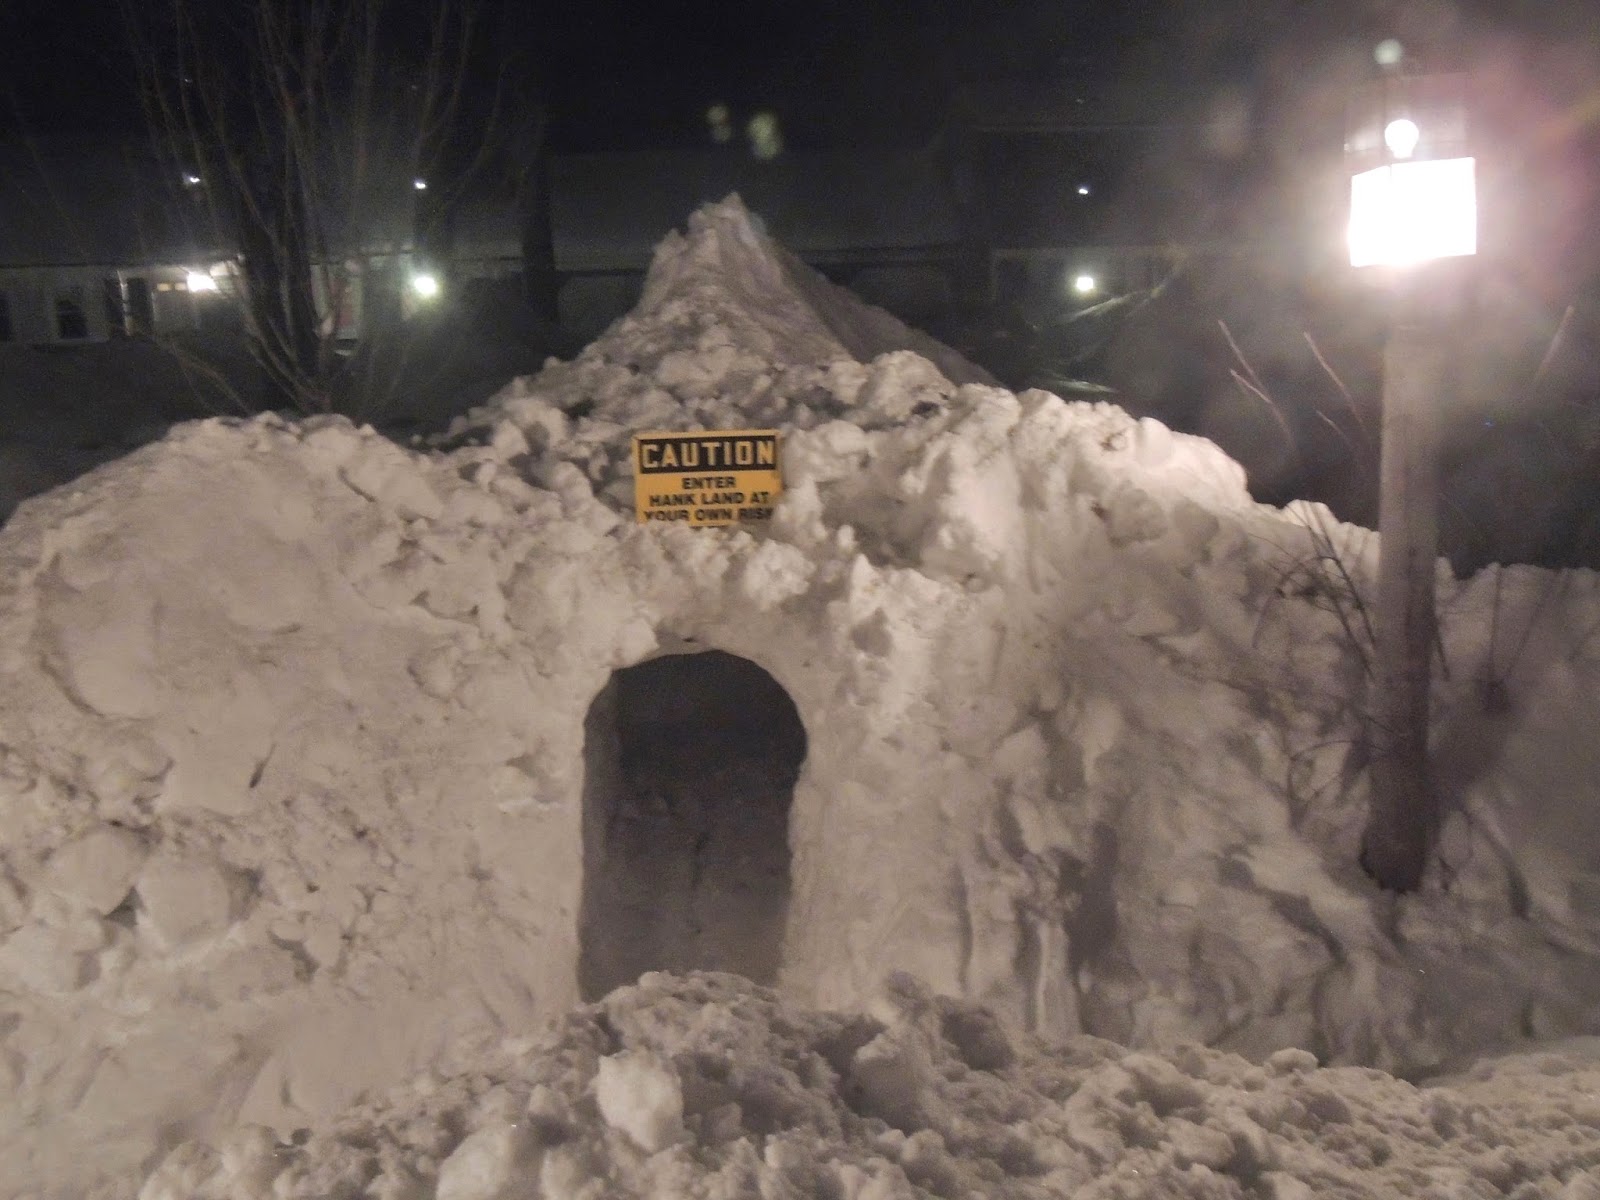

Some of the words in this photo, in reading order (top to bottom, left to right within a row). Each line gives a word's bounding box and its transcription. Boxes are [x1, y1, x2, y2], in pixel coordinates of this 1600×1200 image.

[642, 440, 774, 467] CAUTION
[682, 477, 736, 489] ENTER
[650, 494, 696, 507] HANK
[701, 492, 744, 504] LAND
[750, 491, 769, 503] AT
[644, 509, 689, 521] YOUR
[694, 508, 732, 520] OWN
